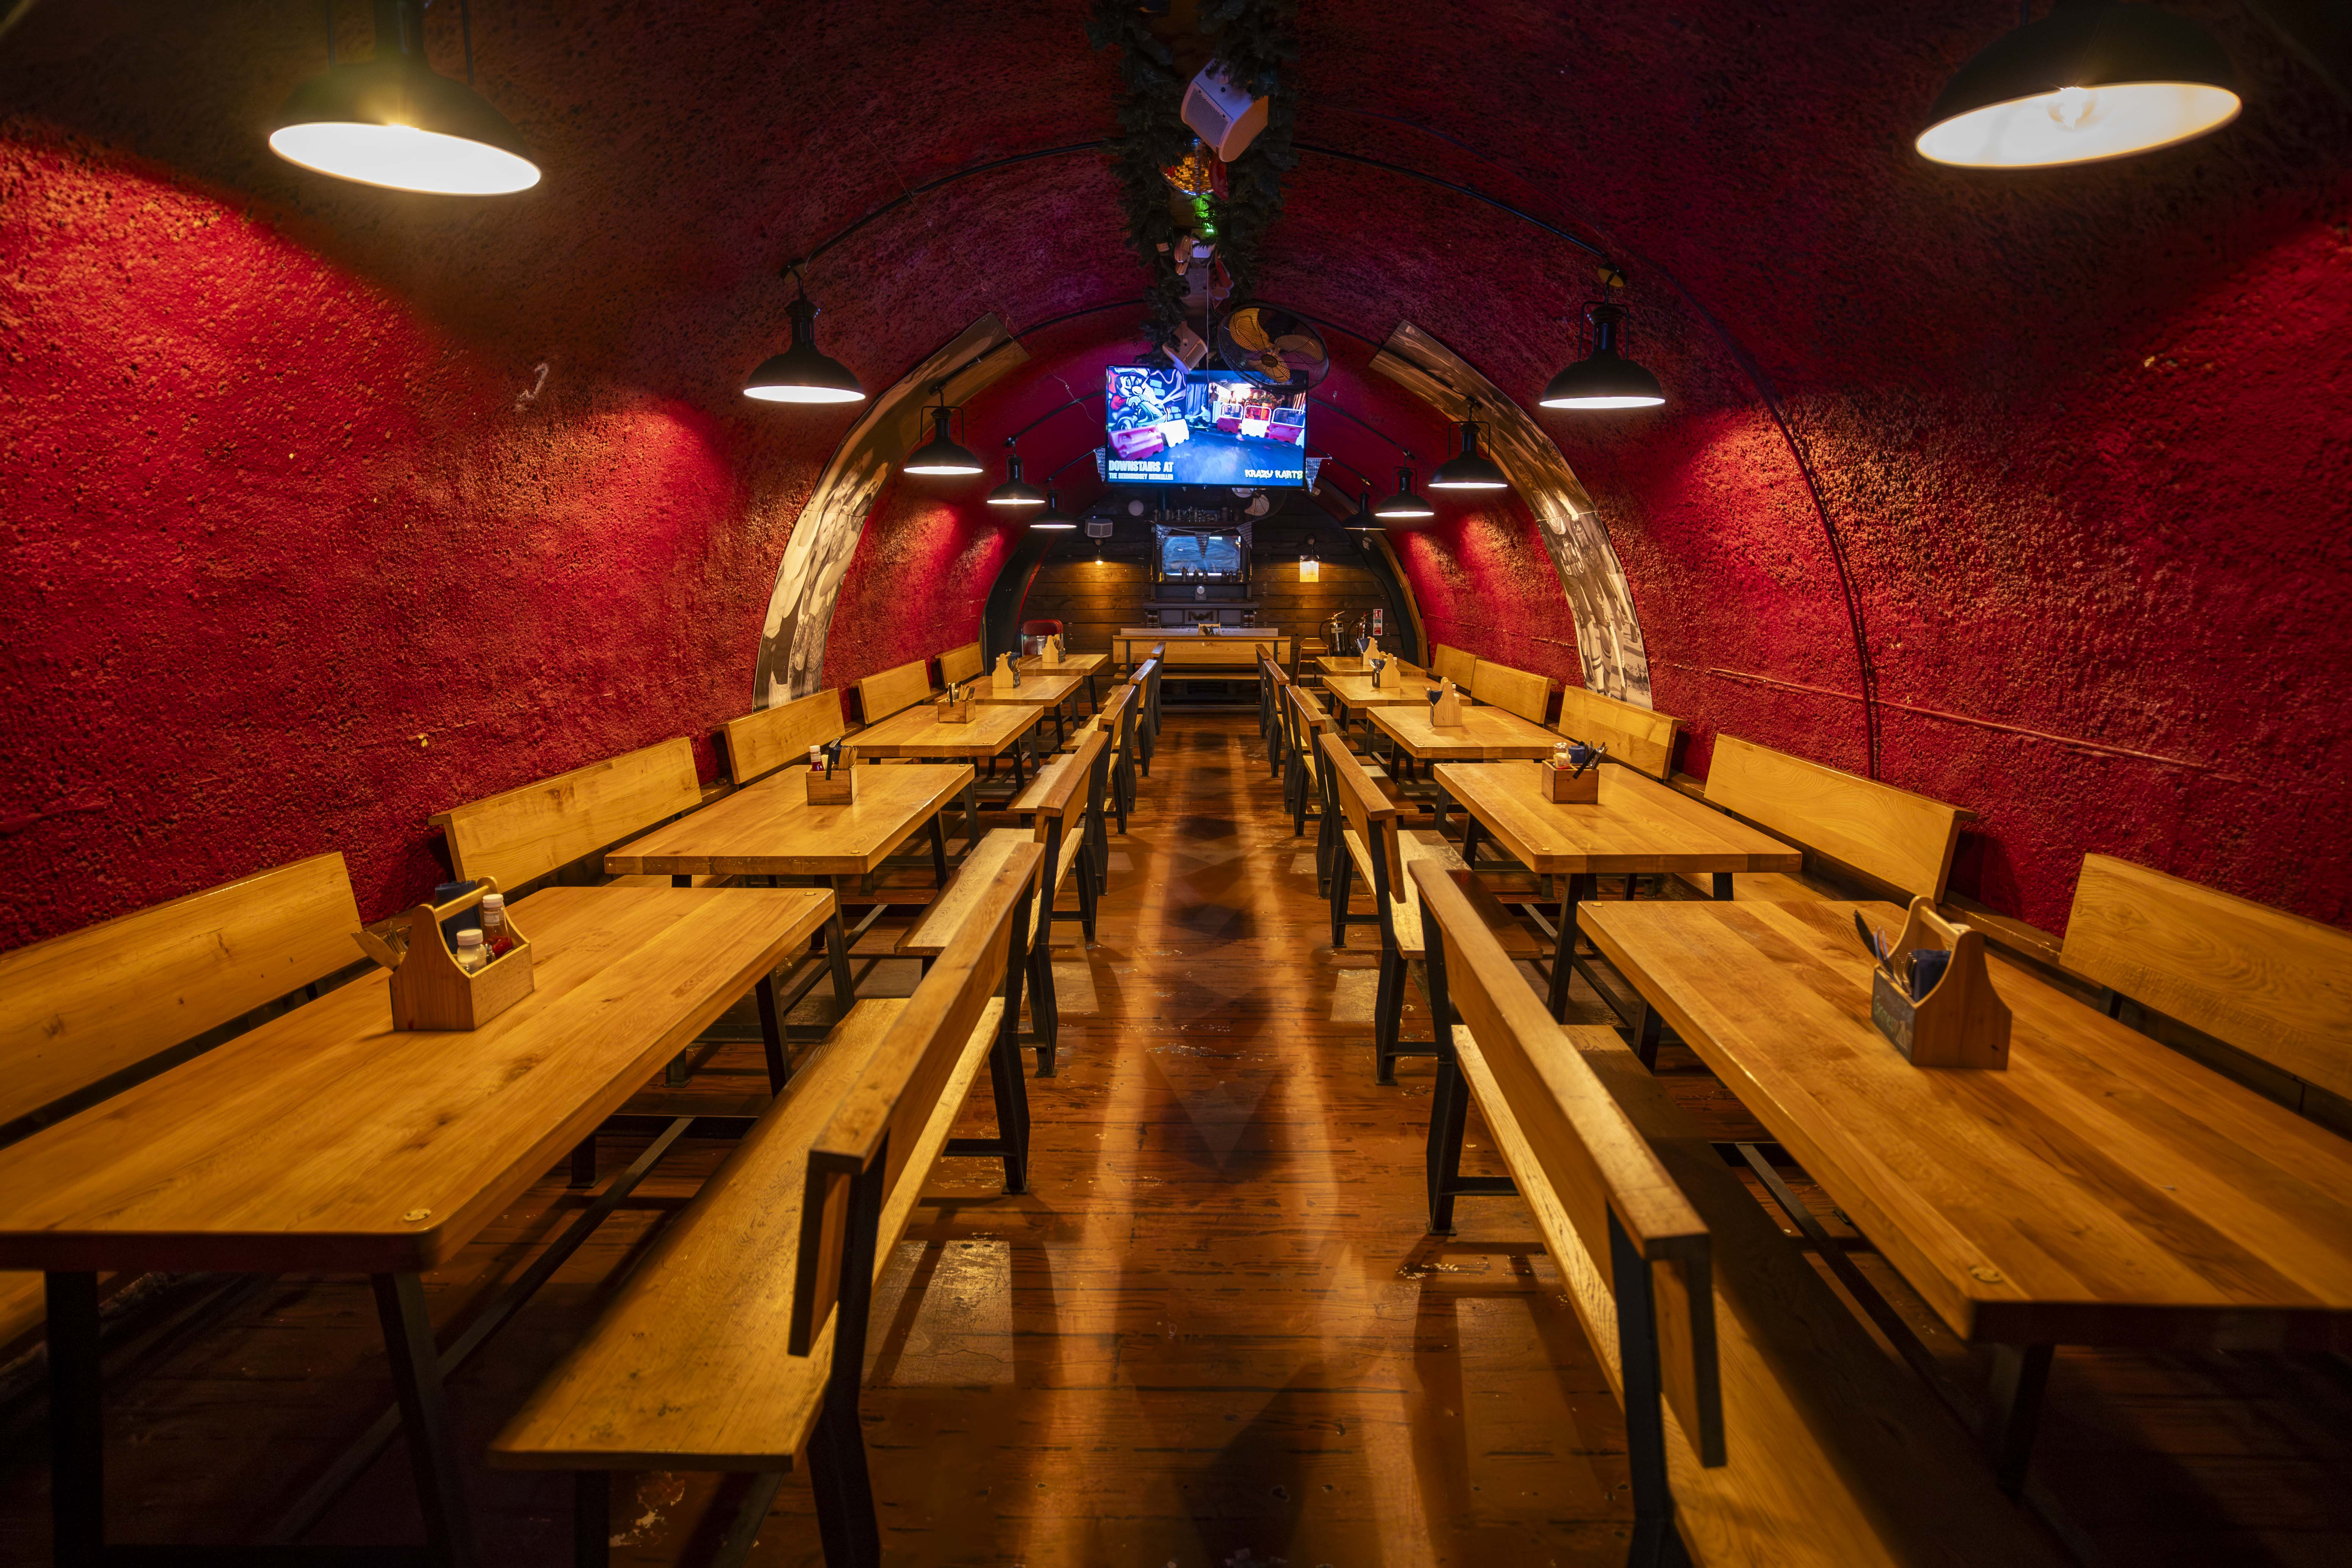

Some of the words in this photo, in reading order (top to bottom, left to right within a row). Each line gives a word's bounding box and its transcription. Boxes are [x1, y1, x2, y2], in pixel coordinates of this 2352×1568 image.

[1109, 460, 1161, 472] DOWNSTAIRS
[1163, 462, 1174, 472] AT
[1245, 469, 1273, 479] KRAZY
[1275, 470, 1303, 480] KARTS
